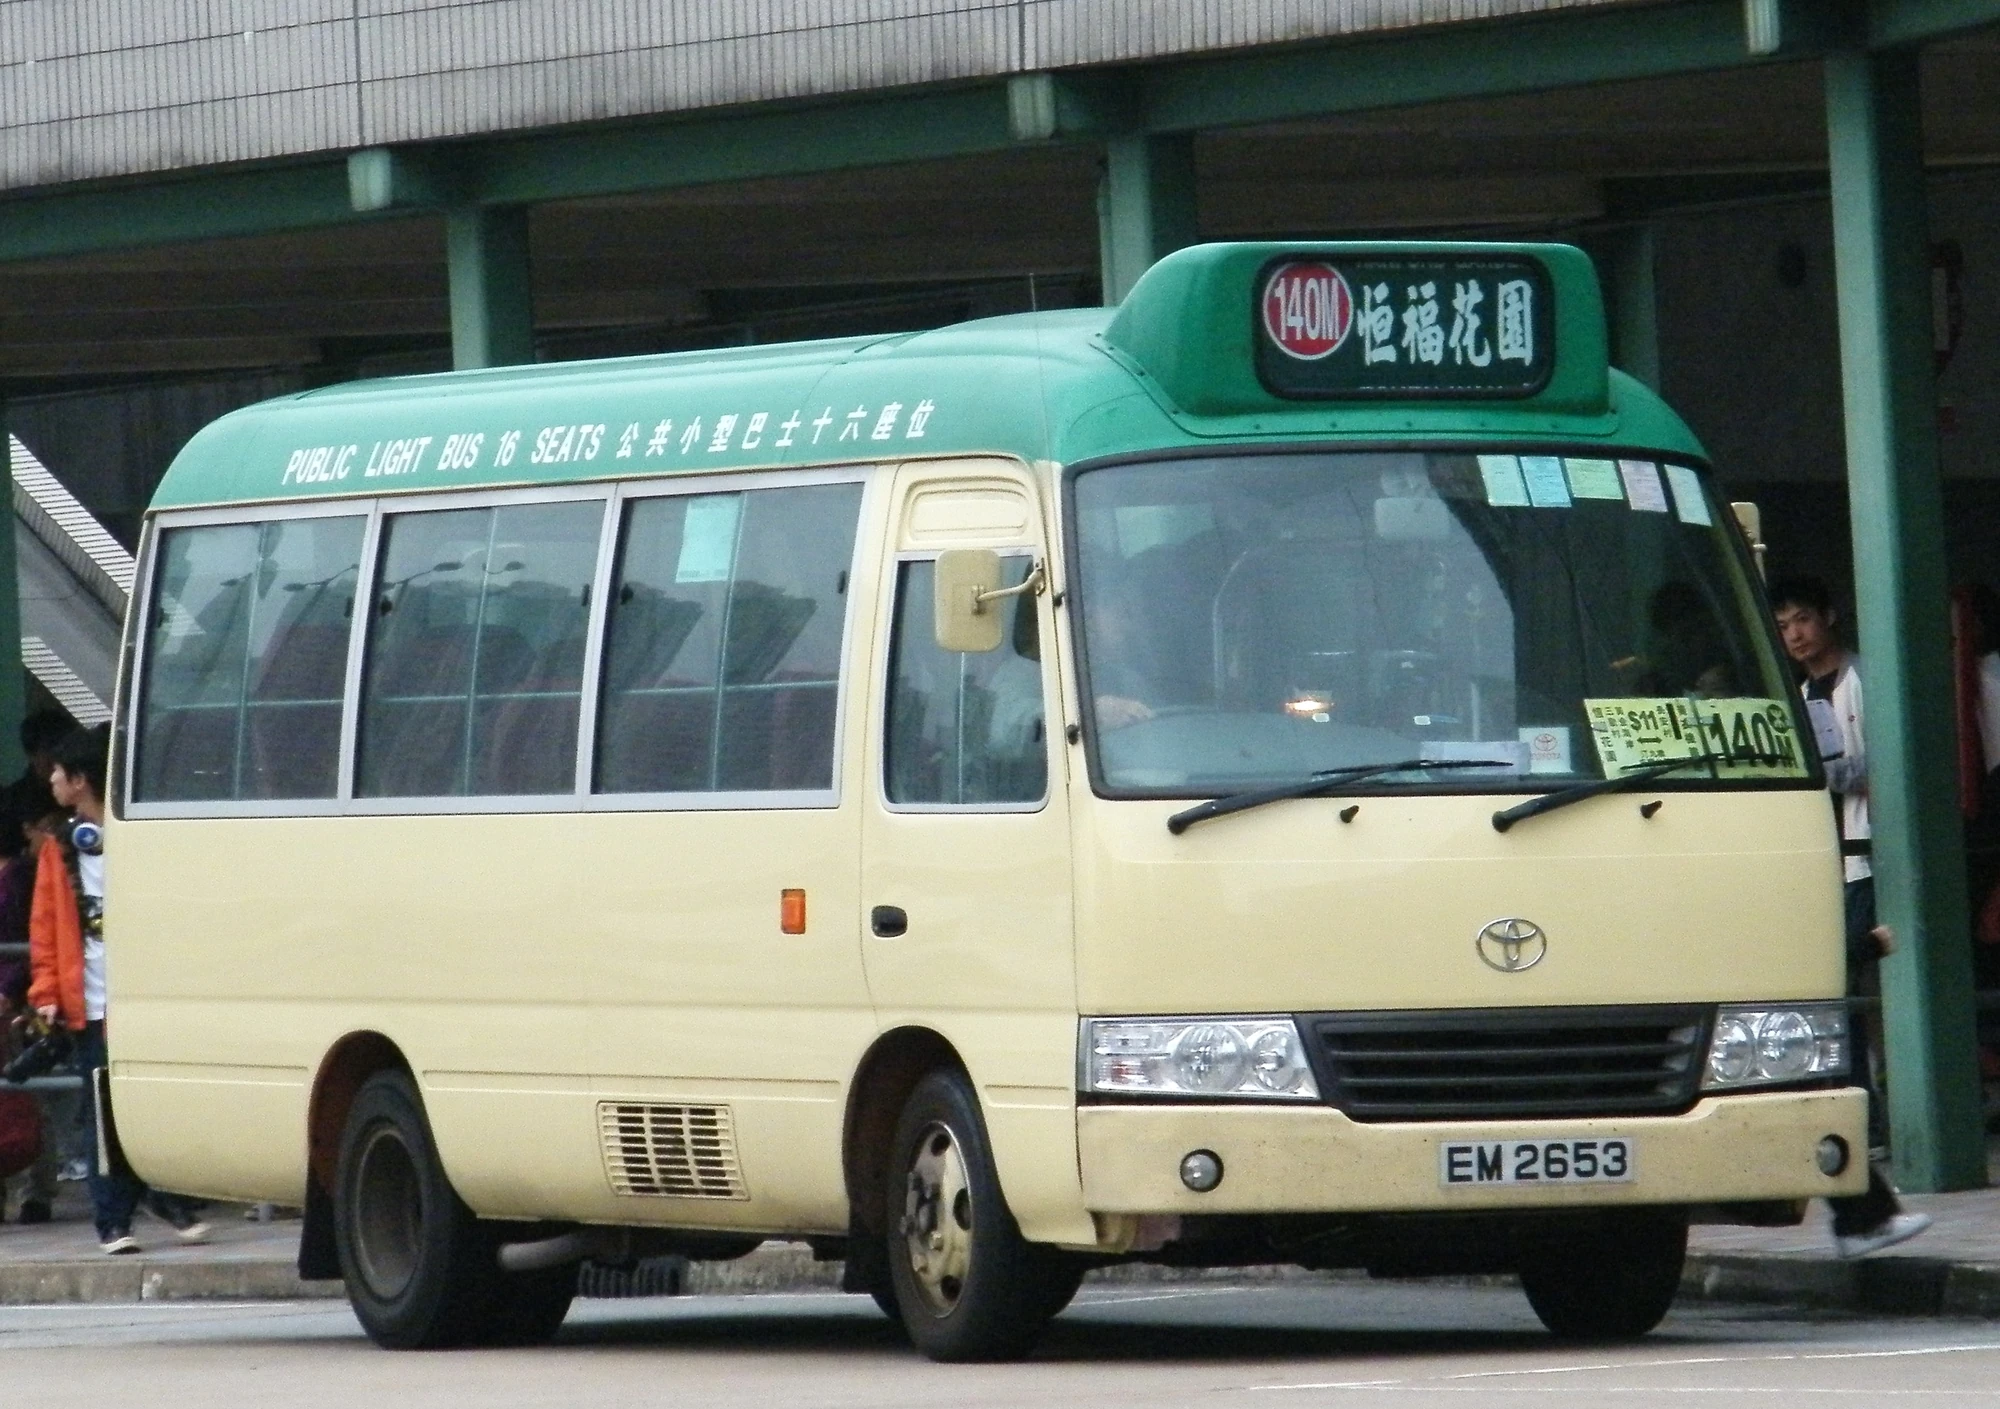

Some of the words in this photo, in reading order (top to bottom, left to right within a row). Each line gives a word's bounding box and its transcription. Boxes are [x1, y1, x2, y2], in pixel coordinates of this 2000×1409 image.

[1274, 277, 1340, 341] 140M
[1357, 279, 1534, 367] 恒福花園
[281, 444, 357, 486] PUBLIC
[364, 436, 433, 477] LIGHT
[436, 432, 484, 471] BUS
[493, 430, 521, 467] 16
[531, 423, 607, 464] SEATS
[615, 398, 936, 458] 公共小型巴士十六座位
[1627, 710, 1659, 731] S11
[1447, 1145, 1503, 1183] EM
[1514, 1141, 1628, 1180] 2653
